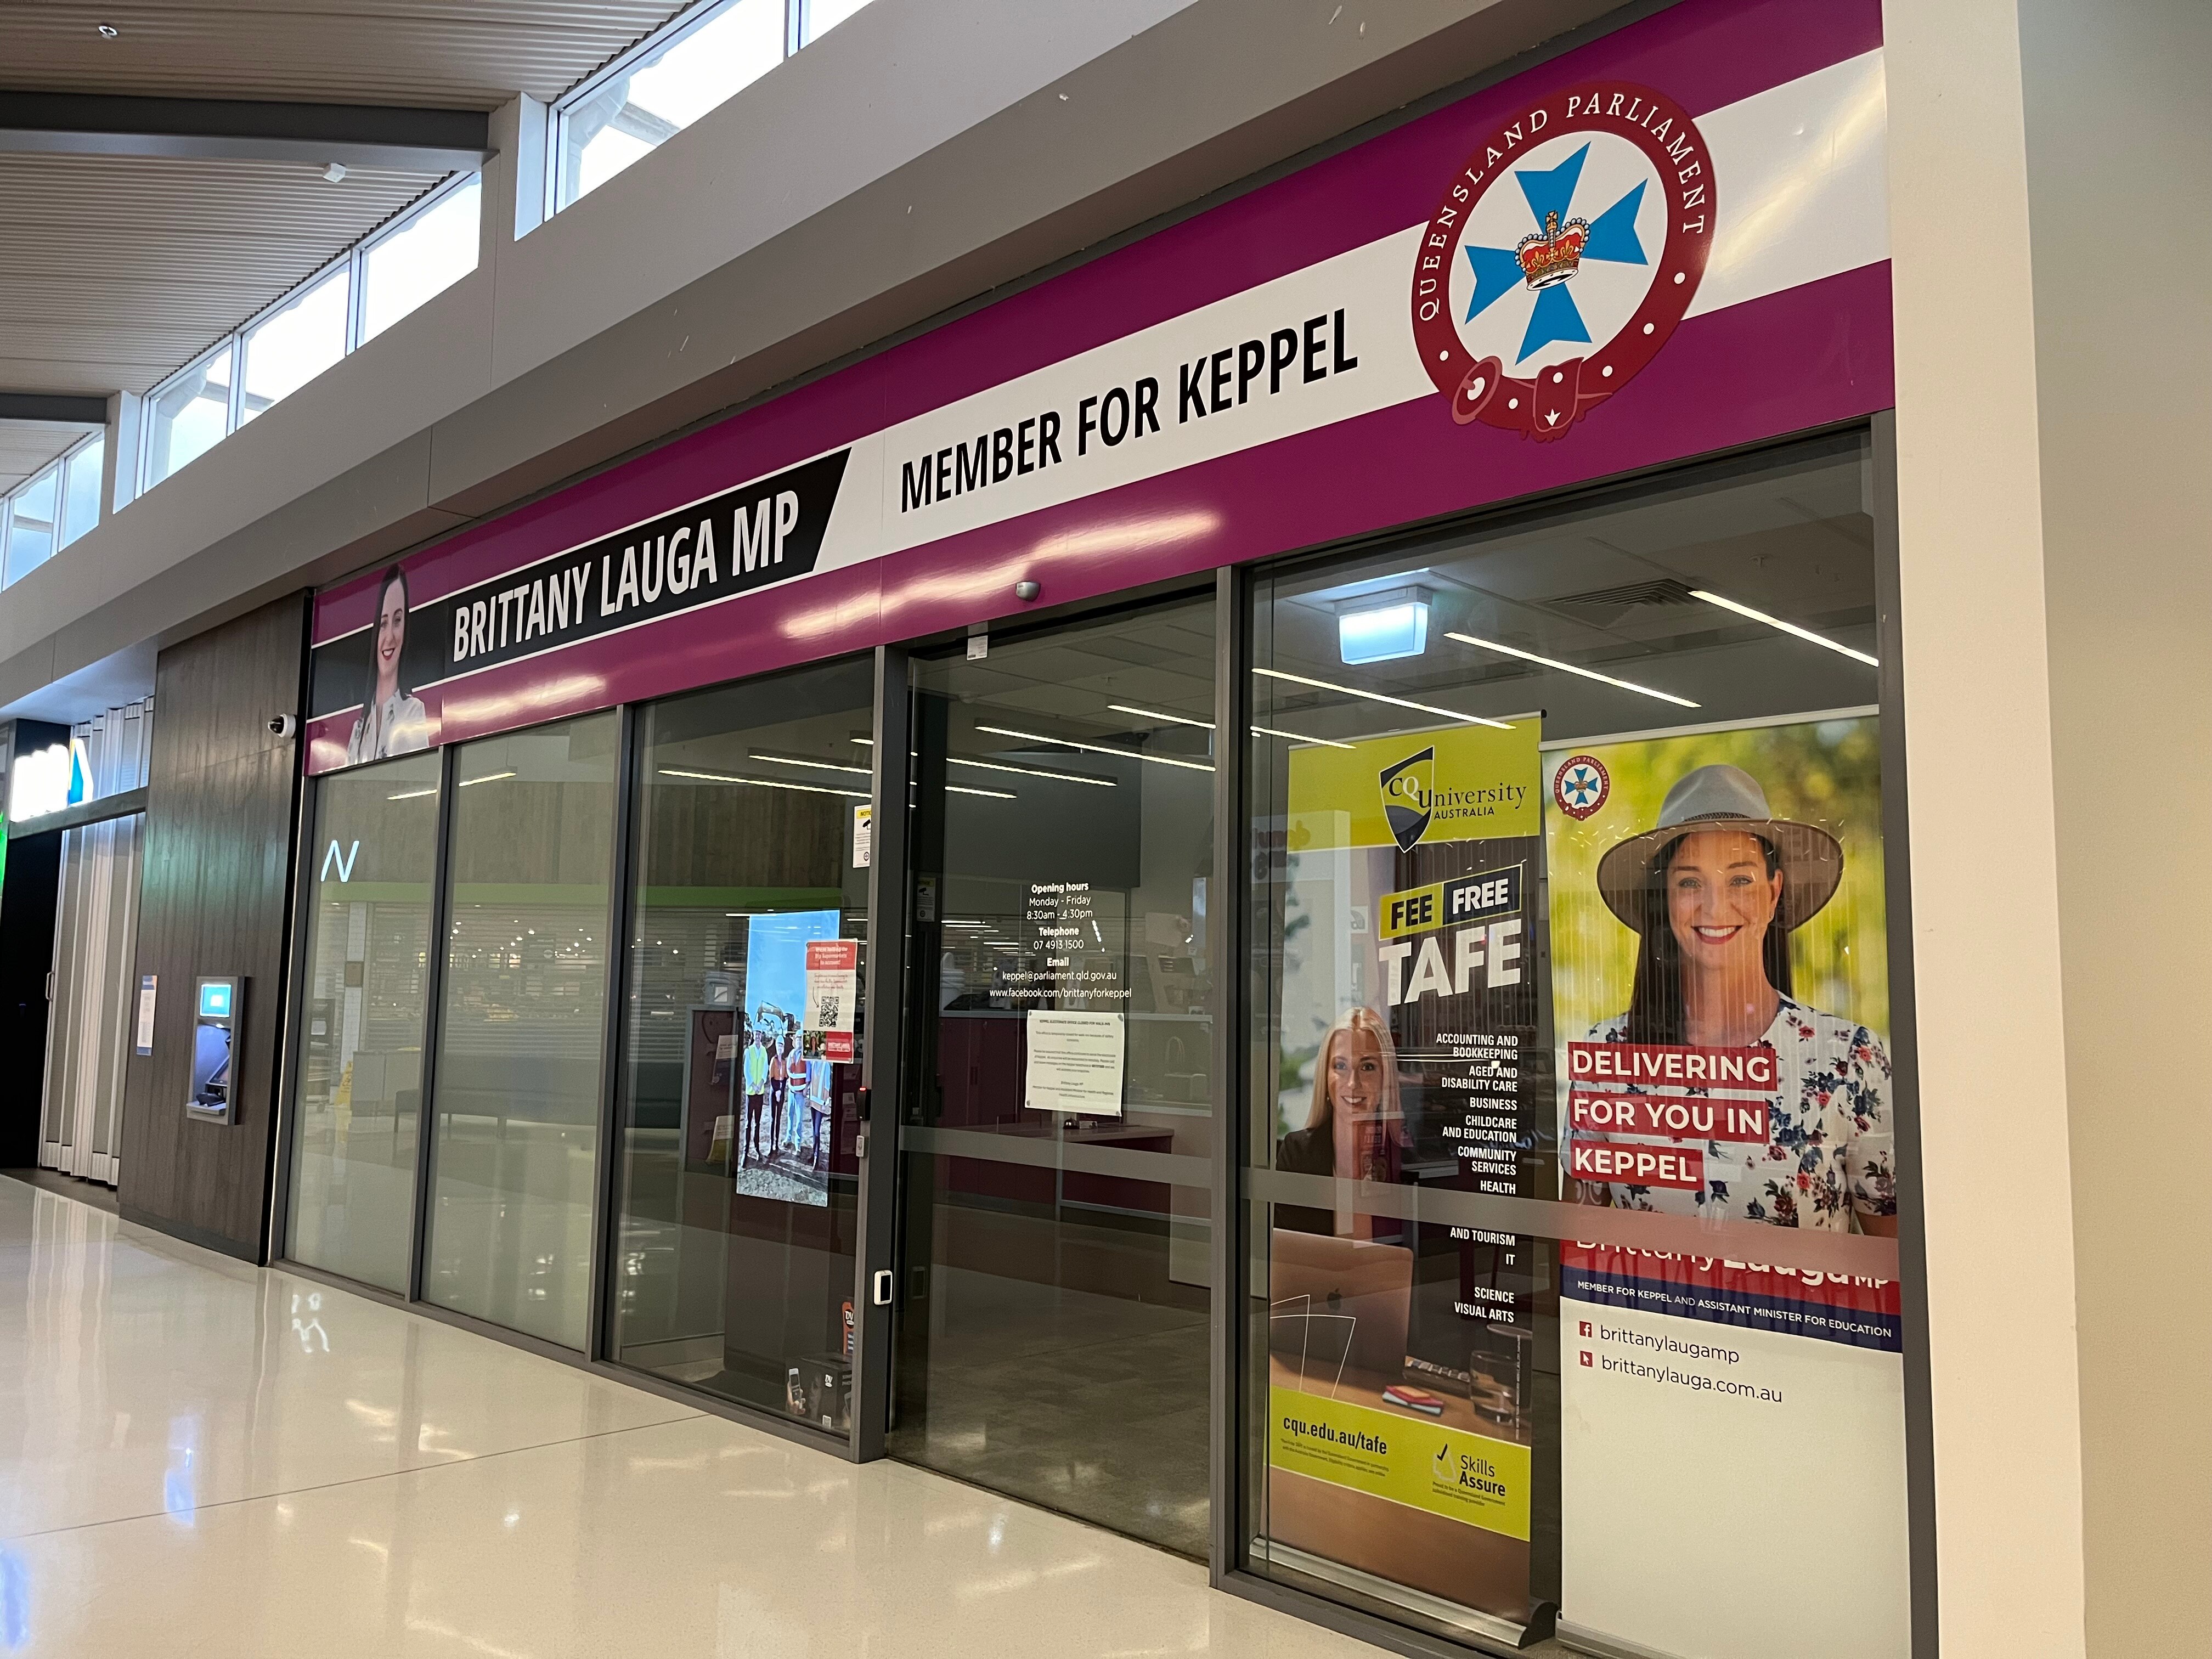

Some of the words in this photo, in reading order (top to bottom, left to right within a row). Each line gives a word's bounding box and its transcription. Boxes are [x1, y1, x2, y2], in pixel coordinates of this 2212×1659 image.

[1419, 109, 1548, 321] QUEENSLAND
[1566, 92, 1705, 235] PARLIAMENT
[901, 410, 1061, 514] MEMBER
[1078, 376, 1160, 456] FOR
[1178, 308, 1358, 425] KEPPEL
[453, 561, 592, 662] BRITTANY
[600, 518, 718, 618] LAUGA
[731, 490, 799, 577] MP
[1555, 757, 1581, 794] QUEENSLAND
[1583, 757, 1609, 790] PARLIAMENT
[1434, 806, 1495, 820] AUSTRALIA
[1031, 882, 1064, 895] Opening
[1066, 882, 1089, 891] hours
[1029, 896, 1059, 907] Monday
[1066, 895, 1091, 906] Friday
[1391, 894, 1433, 930] FEE
[1452, 878, 1509, 915] FREE
[1026, 910, 1055, 920] 8:30am
[1062, 909, 1093, 919] 4:30pm
[1039, 926, 1080, 937] Telephone
[1034, 940, 1042, 950] 07
[1045, 940, 1063, 950] 4913
[1065, 939, 1084, 950] 1500
[1047, 957, 1069, 967] Email
[1378, 918, 1522, 1006] TAFE
[1002, 970, 1117, 981] keppel@parliament.qld.gov.au
[989, 987, 1132, 1000] www.facebook.com/brittanyforkeppel
[1436, 1033, 1494, 1046] ACCOUNTING
[1496, 1035, 1519, 1046] AND
[1453, 1047, 1518, 1060] BOOKKEEPING
[1469, 1065, 1494, 1077] AGED
[1496, 1066, 1518, 1078] AND
[1572, 1049, 1771, 1083] DELIVERING
[1442, 1077, 1491, 1090] DISABILITY
[1492, 1080, 1518, 1092] CARE
[1470, 1097, 1517, 1110] BUSINESS
[1465, 1115, 1517, 1129] CHILDCARE
[1573, 1098, 1636, 1126] FOR
[1644, 1103, 1714, 1132] YOU
[1727, 1108, 1763, 1135] IN
[1442, 1126, 1462, 1138] AND
[1464, 1128, 1517, 1143] EDUCATION
[1458, 1146, 1516, 1162] COMMUNITY
[1471, 1160, 1516, 1176] SERVICES
[1575, 1147, 1697, 1183] KEPPEL
[1480, 1180, 1516, 1194] HEALTH
[1450, 1227, 1470, 1240] AND
[1471, 1229, 1515, 1246] TOURISM
[1506, 1254, 1515, 1265] IT
[1474, 1286, 1514, 1304] SCIENCE
[1454, 1302, 1487, 1318] VISUAL
[1488, 1308, 1514, 1323] ARTS
[1578, 1280, 1614, 1294] MEMBER
[1616, 1286, 1636, 1297] FOR
[1638, 1290, 1672, 1303] KEPPEL
[1674, 1295, 1695, 1306] AND
[1697, 1299, 1751, 1314] ASSISTANT
[1753, 1307, 1803, 1323] MINISTER
[1804, 1316, 1826, 1327] FOR
[1828, 1319, 1892, 1338] EDUCATION
[1600, 1324, 1740, 1365] brittanylaugamp
[1601, 1355, 1782, 1403] brittanylauga.com.au
[1283, 1417, 1387, 1454] cqu.edu.au/tafe
[1460, 1455, 1495, 1477] Skills
[1459, 1471, 1505, 1497] Assure
